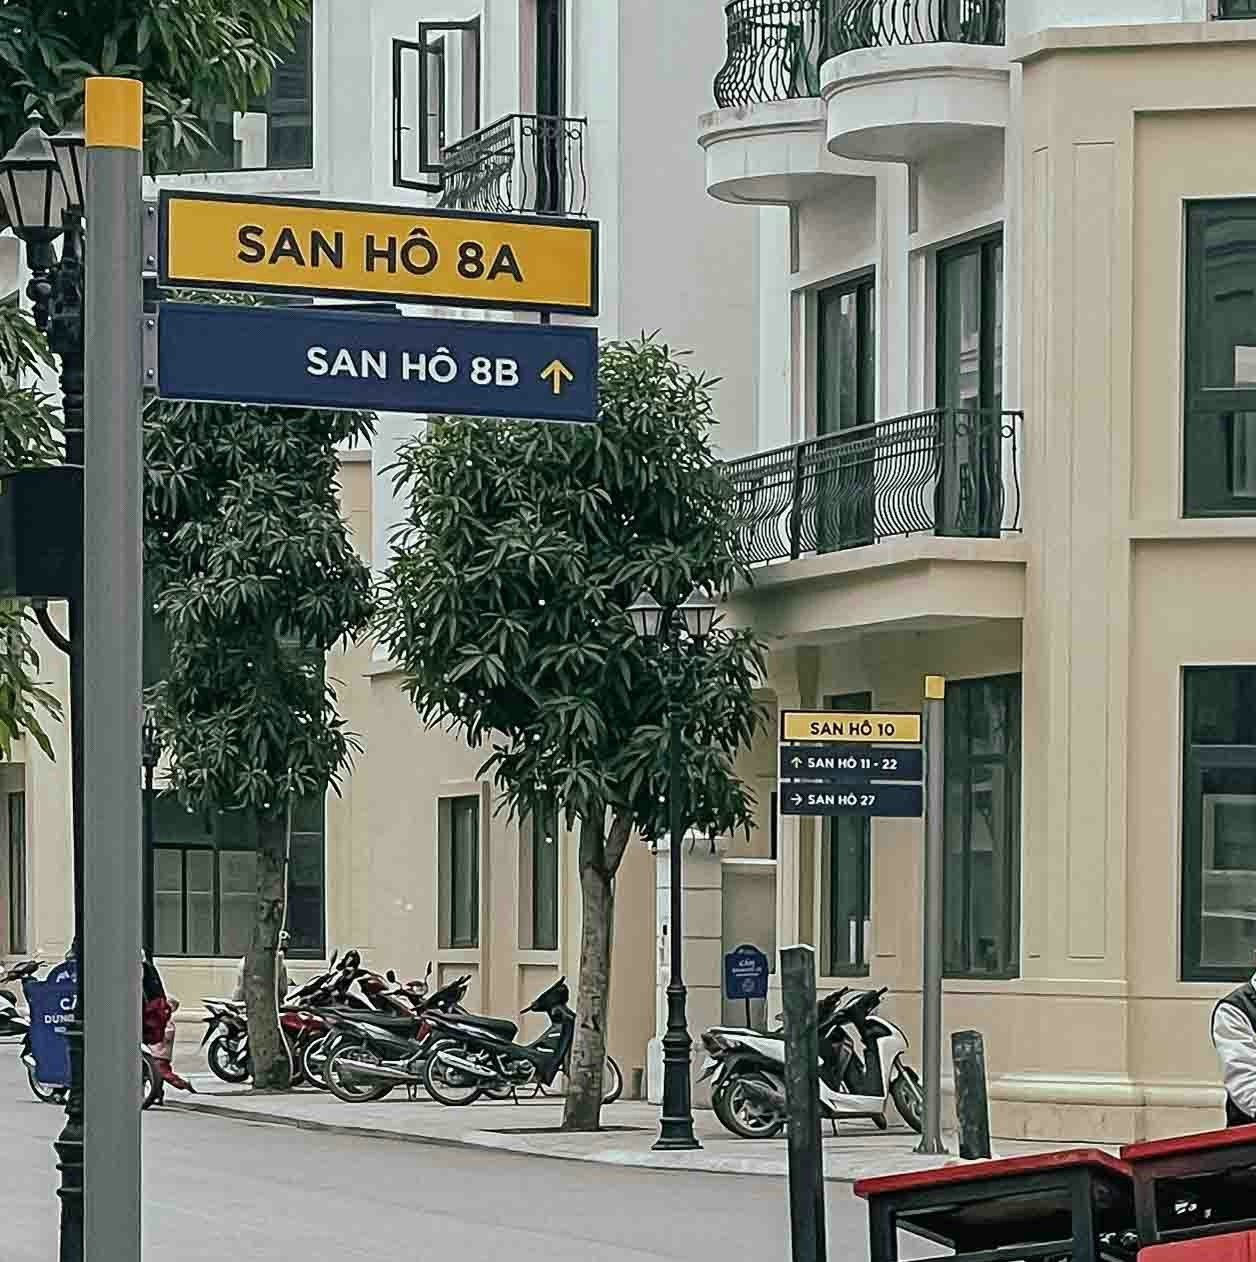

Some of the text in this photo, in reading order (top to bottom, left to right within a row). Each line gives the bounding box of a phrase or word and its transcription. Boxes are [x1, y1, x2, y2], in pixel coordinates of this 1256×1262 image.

[237, 225, 524, 282] SAN HÔ 8A
[307, 347, 519, 386] SAN HÔ 8B
[810, 719, 895, 736] SAN HÔ 10
[808, 757, 834, 768] SAN
[860, 759, 870, 768] 11
[881, 759, 898, 770] 22
[808, 794, 834, 805] SAN
[860, 795, 876, 805] 27
